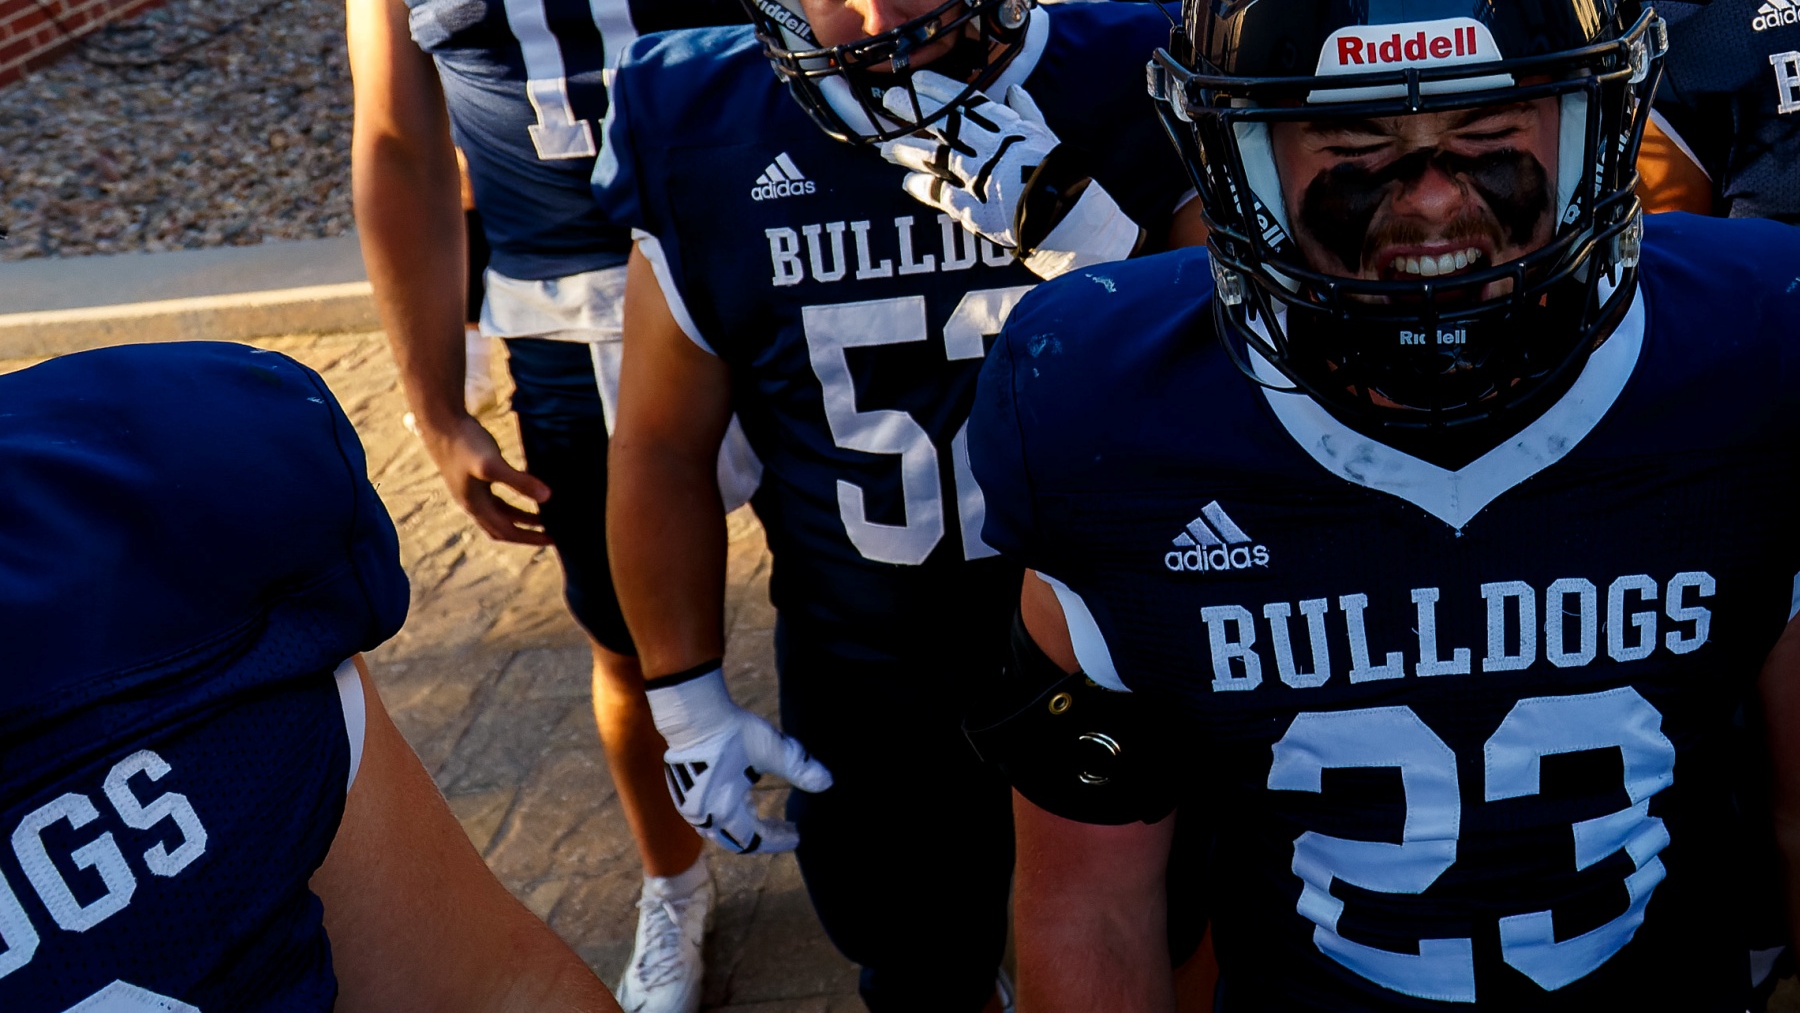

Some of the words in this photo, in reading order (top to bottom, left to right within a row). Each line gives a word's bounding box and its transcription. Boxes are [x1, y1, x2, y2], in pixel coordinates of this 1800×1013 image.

[1337, 26, 1478, 65] Riddell
[751, 179, 816, 200] adidas
[765, 214, 1014, 286] BULLD
[1165, 542, 1269, 573] adidas
[1200, 571, 1716, 692] BULLDOGS
[1267, 685, 1676, 1004] 23
